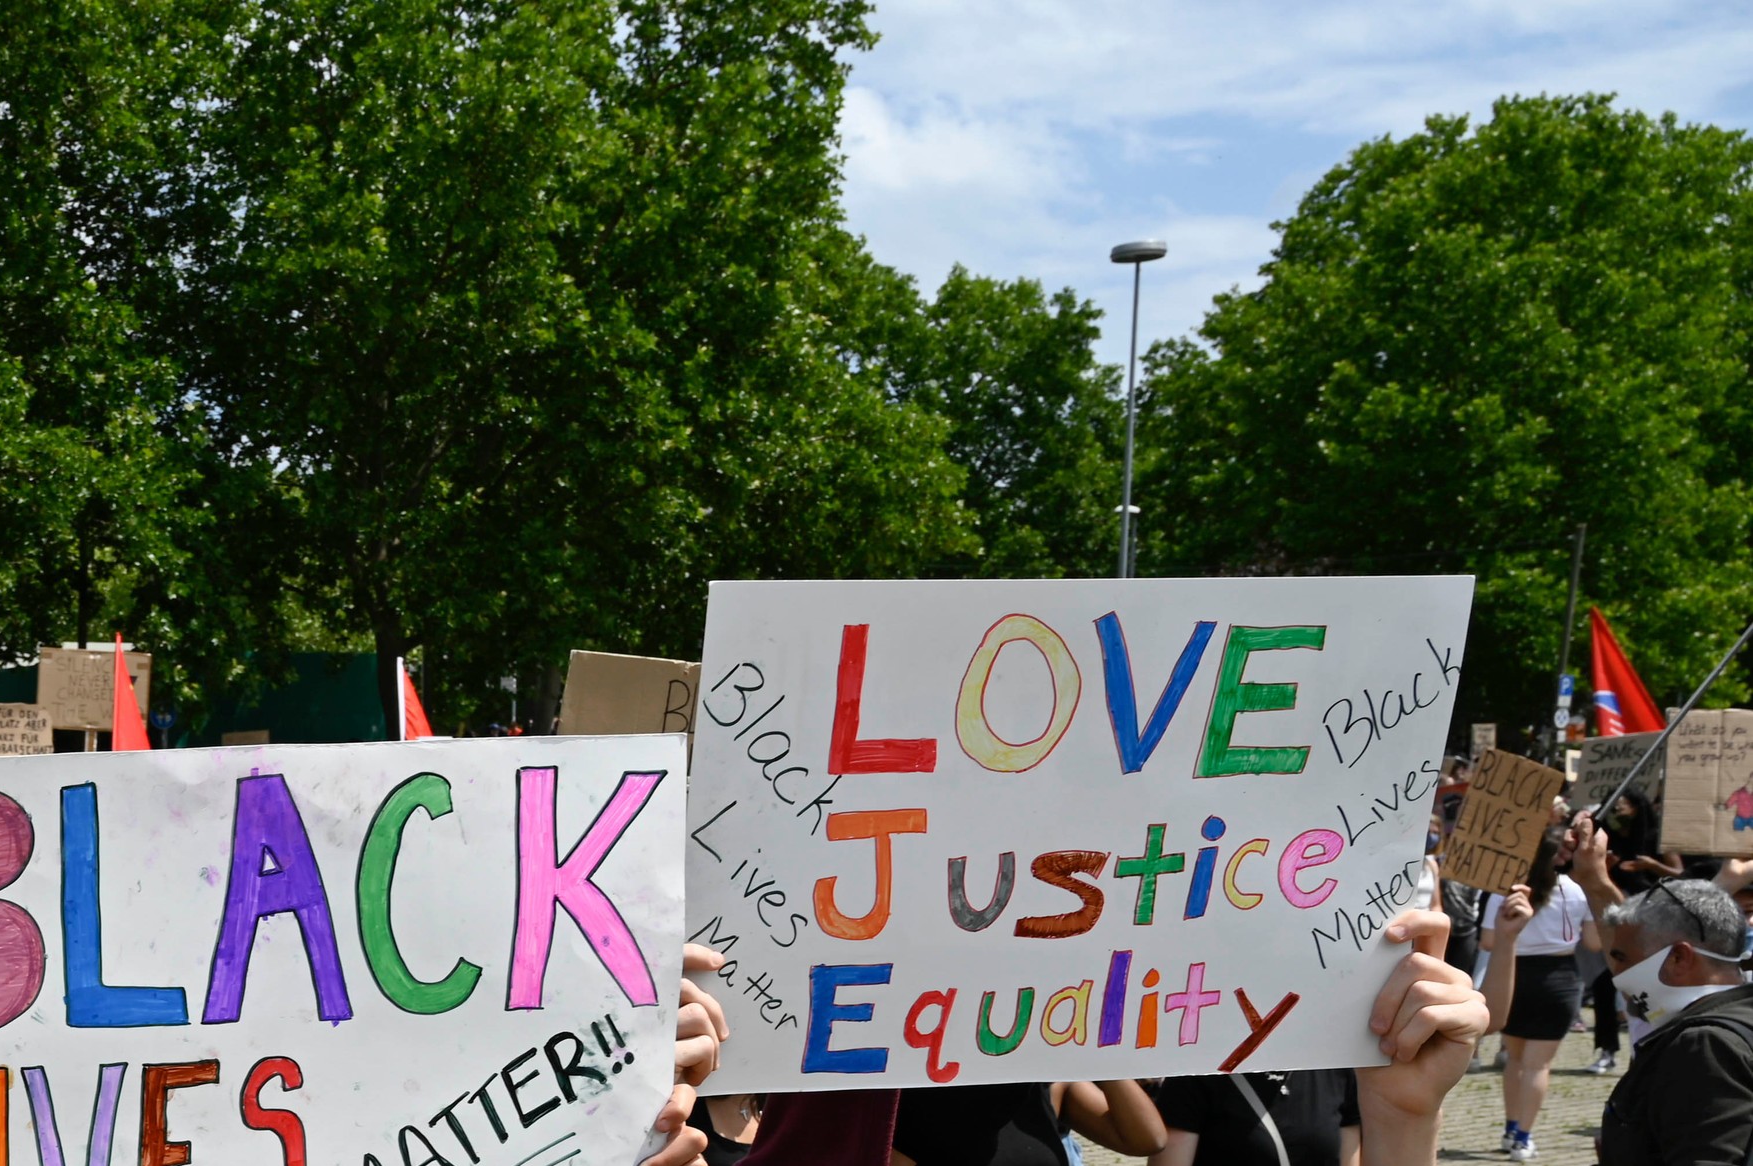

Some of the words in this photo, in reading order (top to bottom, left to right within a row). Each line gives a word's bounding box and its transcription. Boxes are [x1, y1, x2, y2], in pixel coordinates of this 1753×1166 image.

[20, 709, 39, 719] DEN
[21, 732, 39, 744] FÜR
[25, 719, 47, 731] ABER
[827, 610, 1328, 779] LOVE
[1322, 637, 1461, 769] Black
[702, 661, 843, 837] Black
[1473, 749, 1553, 813] BLACK
[1588, 739, 1637, 764] SAME
[1336, 760, 1441, 846] Lives
[1455, 795, 1527, 849] LIVES
[690, 800, 809, 948] Lives
[813, 807, 1345, 942] Justice
[1444, 835, 1530, 891] MATTER
[1311, 859, 1421, 970] Matter
[687, 916, 798, 1031] Matter
[801, 949, 1300, 1085] Equality
